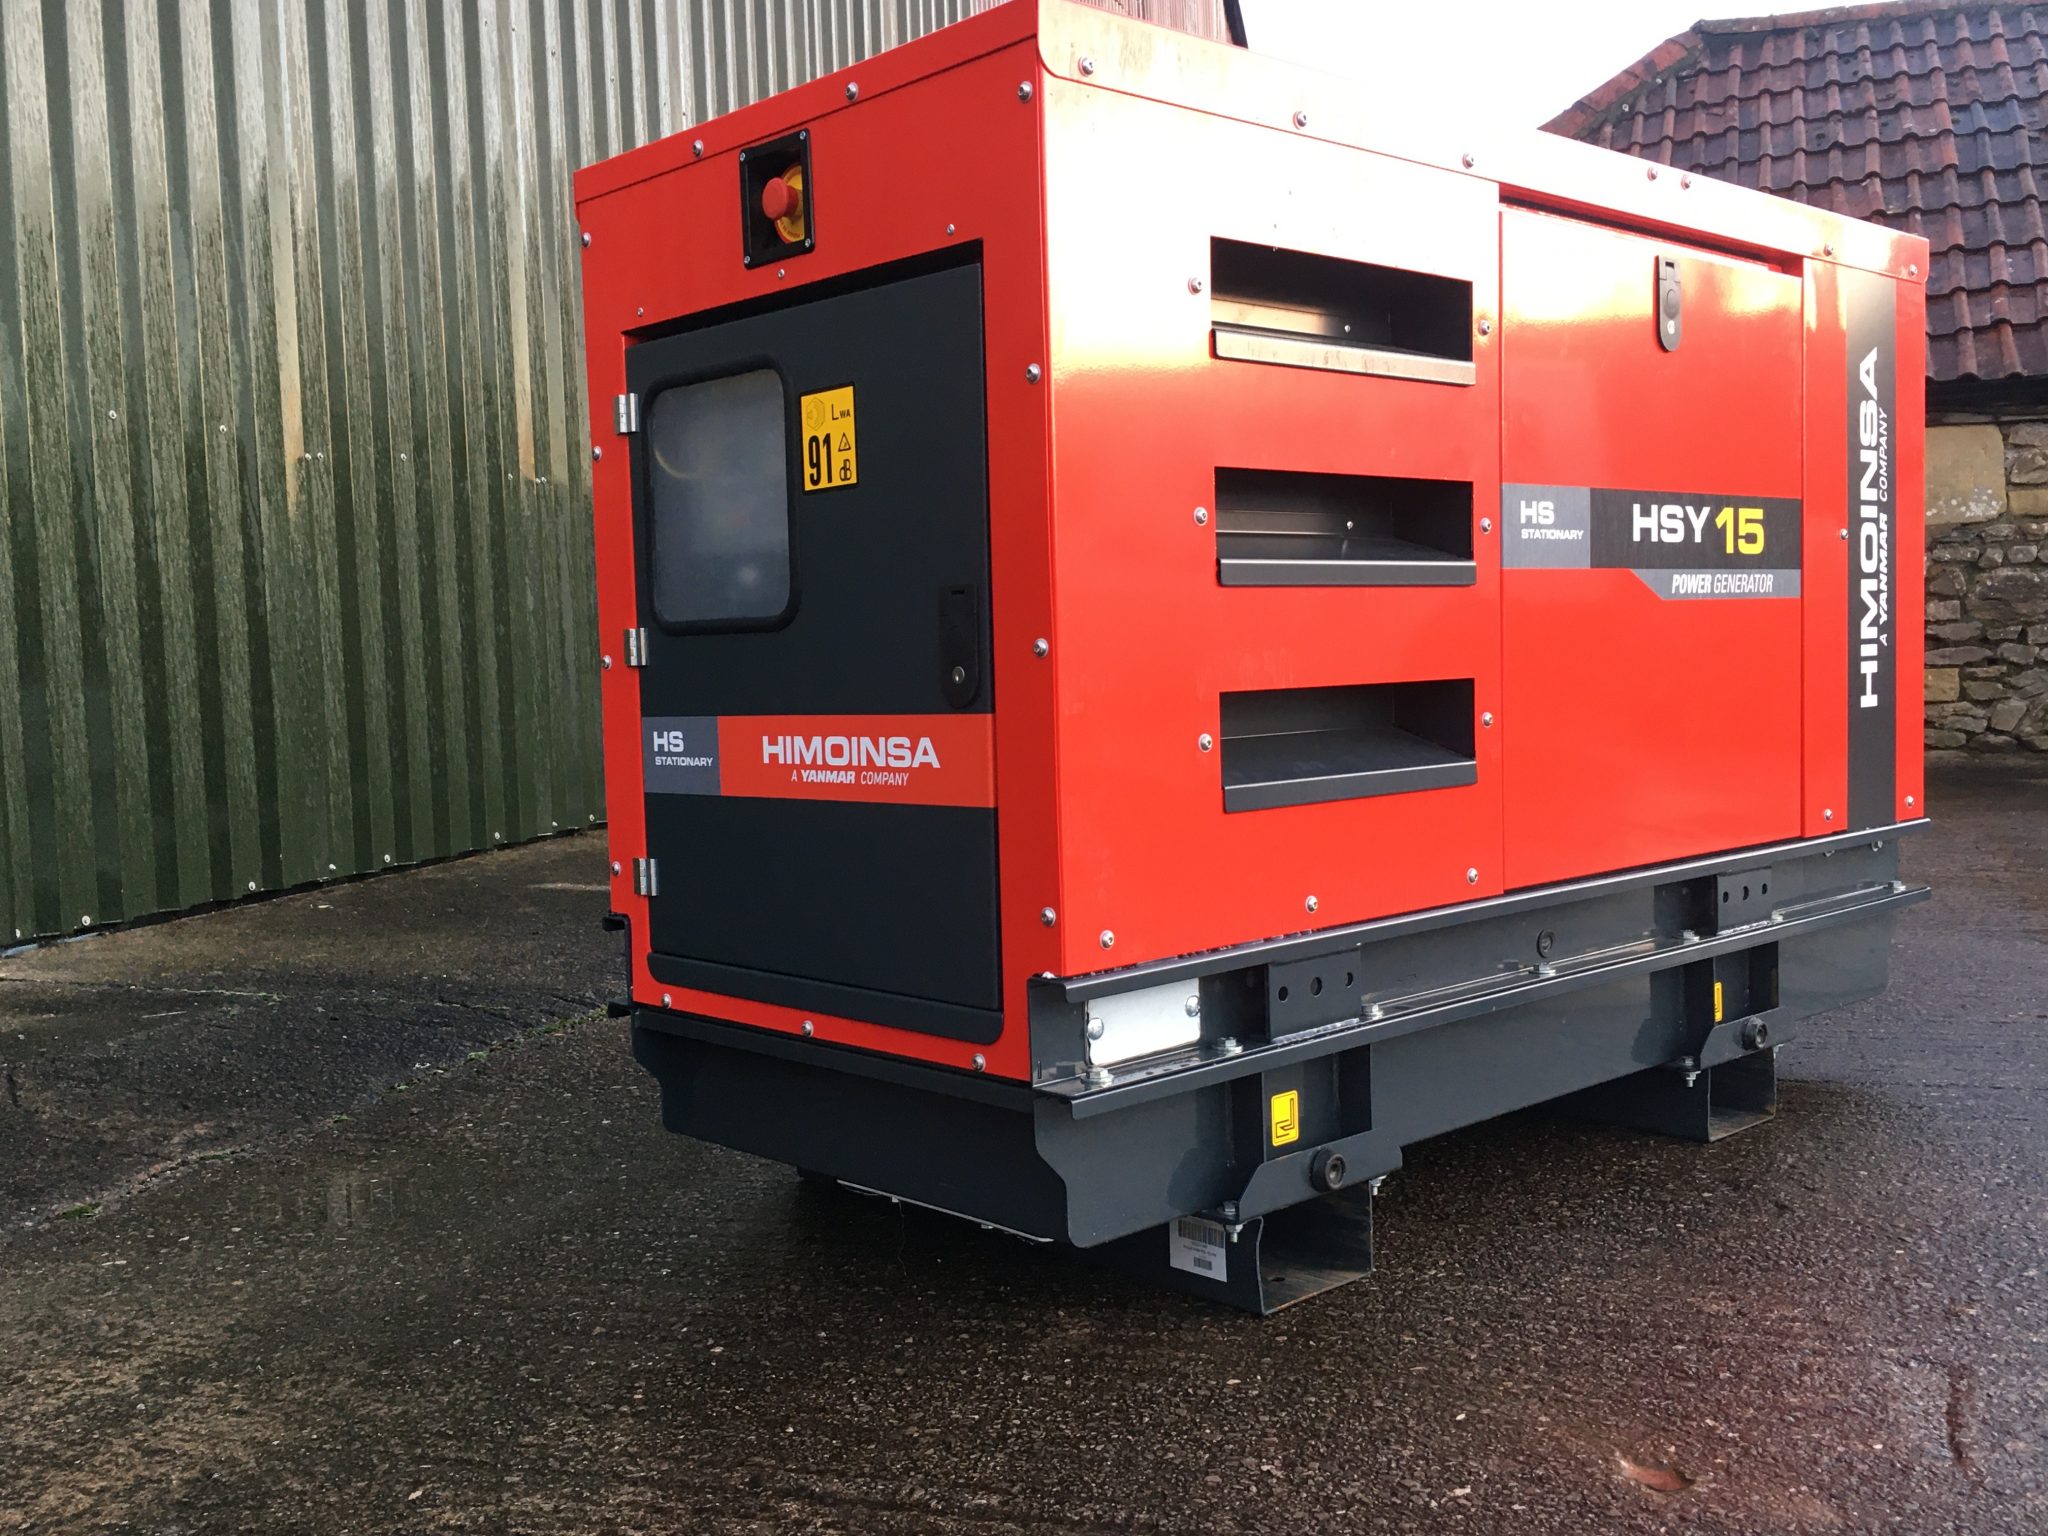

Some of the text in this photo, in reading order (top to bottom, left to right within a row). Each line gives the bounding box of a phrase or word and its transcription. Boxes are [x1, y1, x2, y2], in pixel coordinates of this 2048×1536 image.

[808, 432, 832, 487] 91
[1519, 500, 1555, 525] HS
[1520, 528, 1584, 541] STATIONARY
[1859, 346, 1879, 709] HIMOINSA
[1878, 407, 1889, 647] A YANMAR COMPANY
[1671, 573, 1774, 594] POWER GENERATOR
[653, 731, 685, 753] HS
[762, 735, 941, 769] HIMOINSA
[655, 756, 713, 767] STATIONARY
[791, 769, 910, 787] A YANMAR COMPANY
